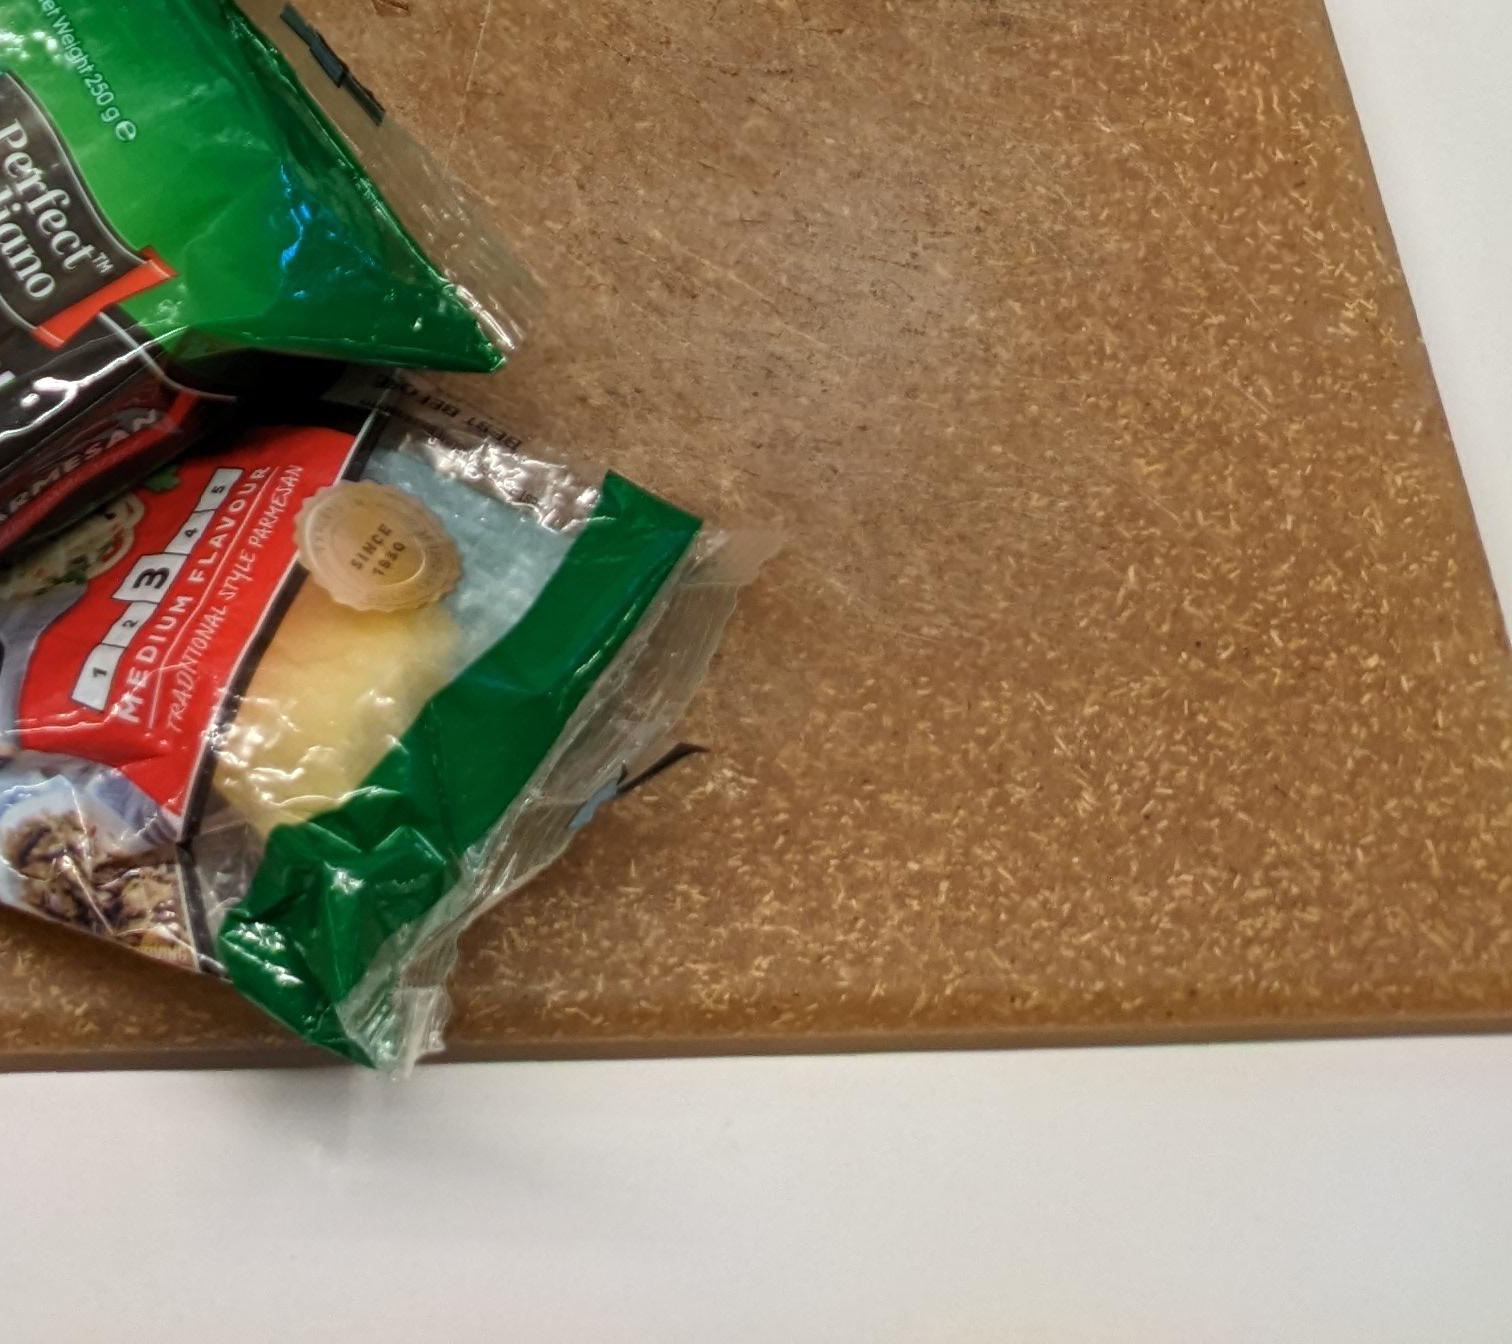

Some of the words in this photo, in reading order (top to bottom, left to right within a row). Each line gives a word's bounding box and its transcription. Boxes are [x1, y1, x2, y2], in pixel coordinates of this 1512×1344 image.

[51, 14, 96, 75] Weight
[83, 72, 115, 107] 250
[92, 667, 108, 678] 1
[121, 618, 138, 630] 2
[132, 566, 170, 590] 3
[183, 527, 198, 538] 4
[211, 484, 225, 495] 5
[218, 549, 257, 602] STYLE
[248, 464, 304, 549] PARMESAN
[348, 521, 395, 574] SINCE
[370, 538, 408, 580] 1930
[114, 595, 195, 726] MEDIUM
[187, 466, 271, 584] FLAVOUR
